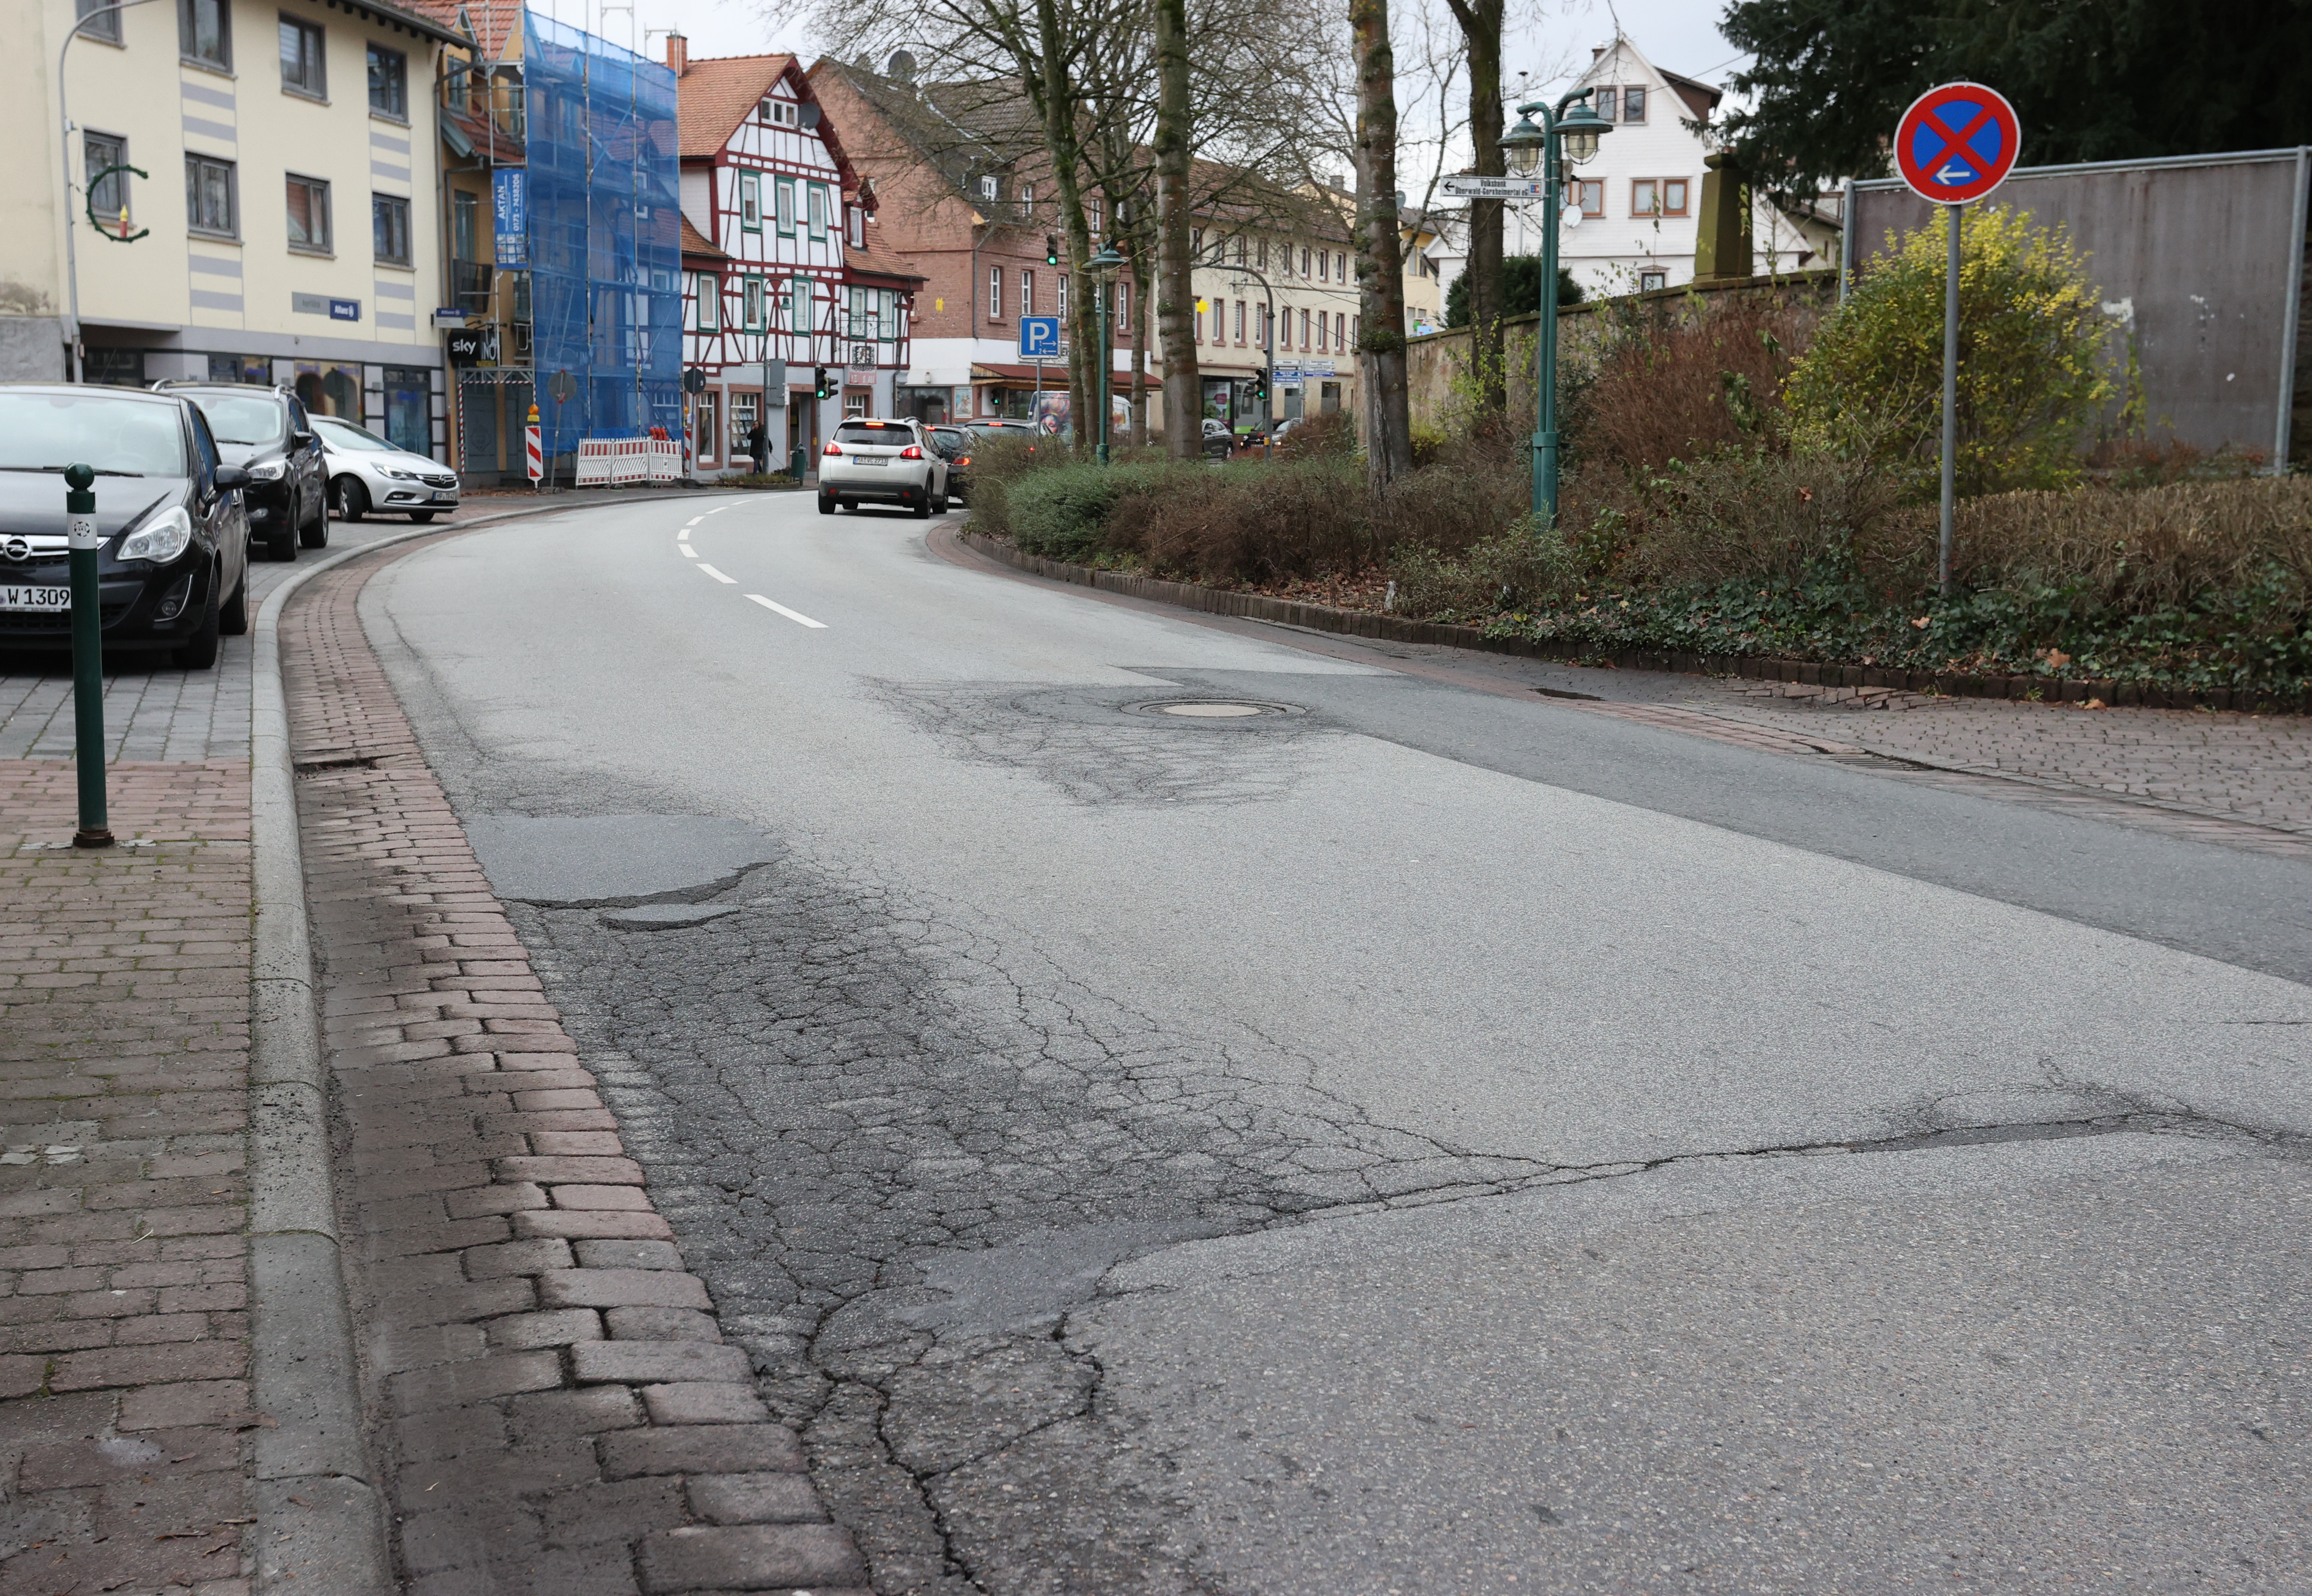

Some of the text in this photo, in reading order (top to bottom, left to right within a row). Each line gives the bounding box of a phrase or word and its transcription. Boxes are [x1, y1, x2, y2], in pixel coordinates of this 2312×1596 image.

[497, 185, 506, 219] AKTAN
[453, 338, 476, 355] sky
[1030, 322, 1050, 351] P
[8, 588, 70, 605] W 1309
